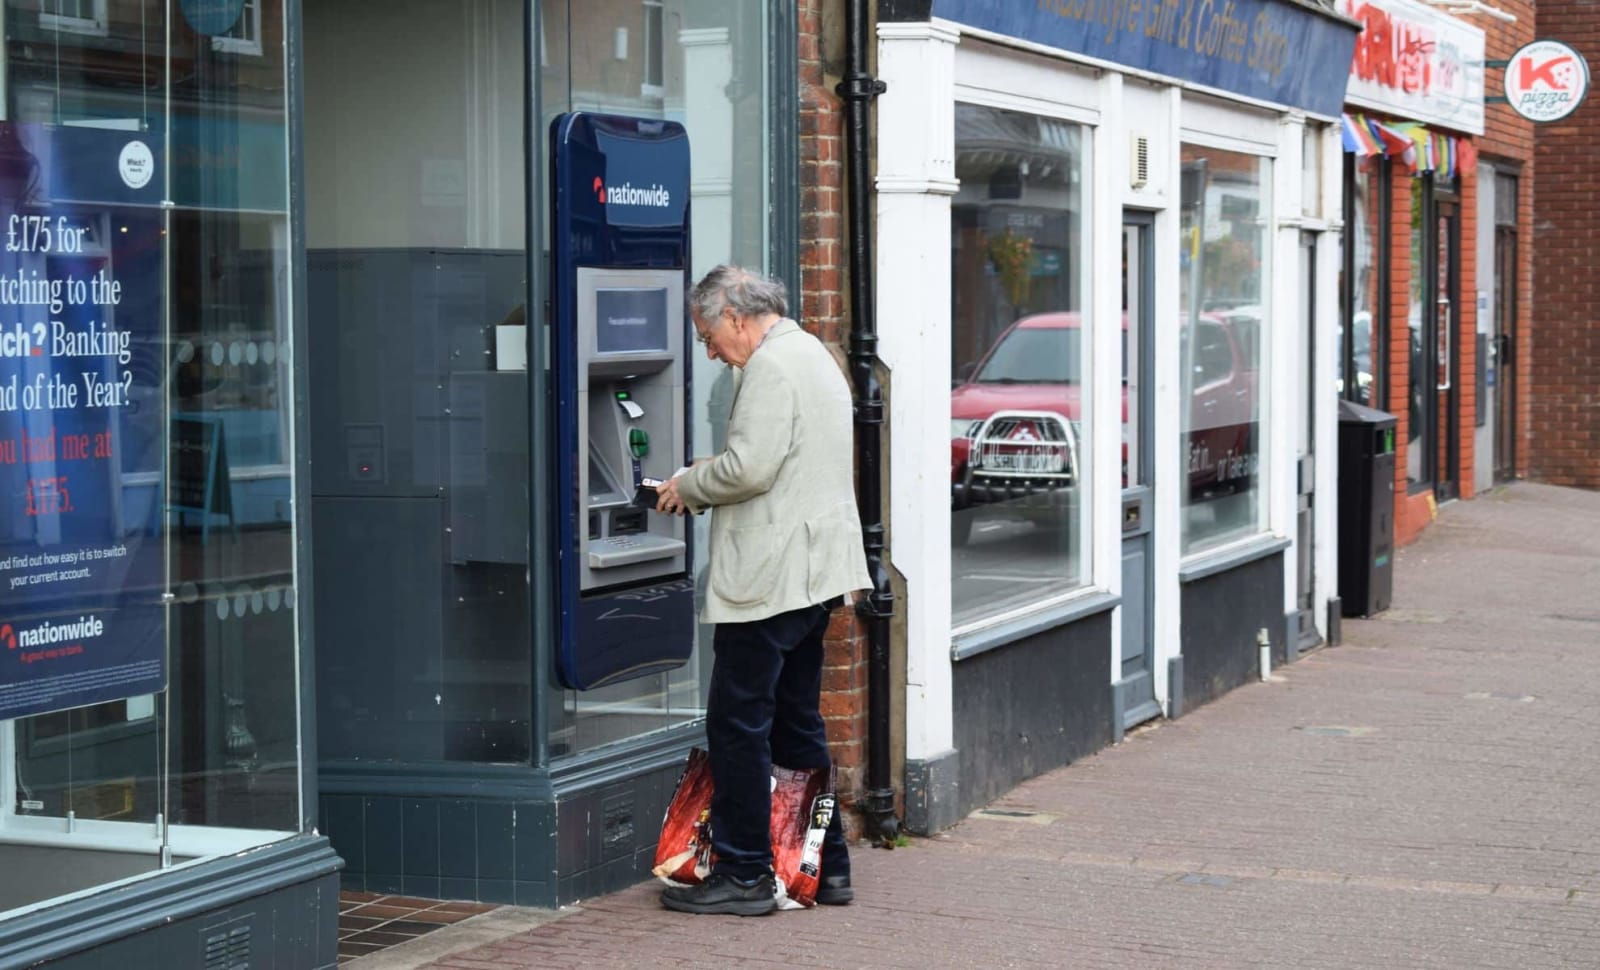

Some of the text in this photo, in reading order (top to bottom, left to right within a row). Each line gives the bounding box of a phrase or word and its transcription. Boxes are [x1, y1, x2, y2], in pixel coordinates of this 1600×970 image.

[1195, 0, 1248, 63] Coffee
[1248, 11, 1288, 79] Shop
[1520, 55, 1573, 90] K
[1519, 88, 1572, 109] pizza
[607, 182, 669, 207] nationwide
[6, 214, 85, 253] £175 for
[0, 268, 121, 314] tching to the
[51, 320, 131, 364] Banking
[23, 373, 45, 410] of
[47, 372, 78, 409] the
[81, 370, 132, 407] Year?
[22, 426, 56, 463] had
[62, 434, 89, 460] me
[94, 431, 112, 458] at
[0, 544, 127, 570] nd find out how easy it is to switch
[10, 567, 91, 590] your current account.
[19, 614, 103, 648] nationwide
